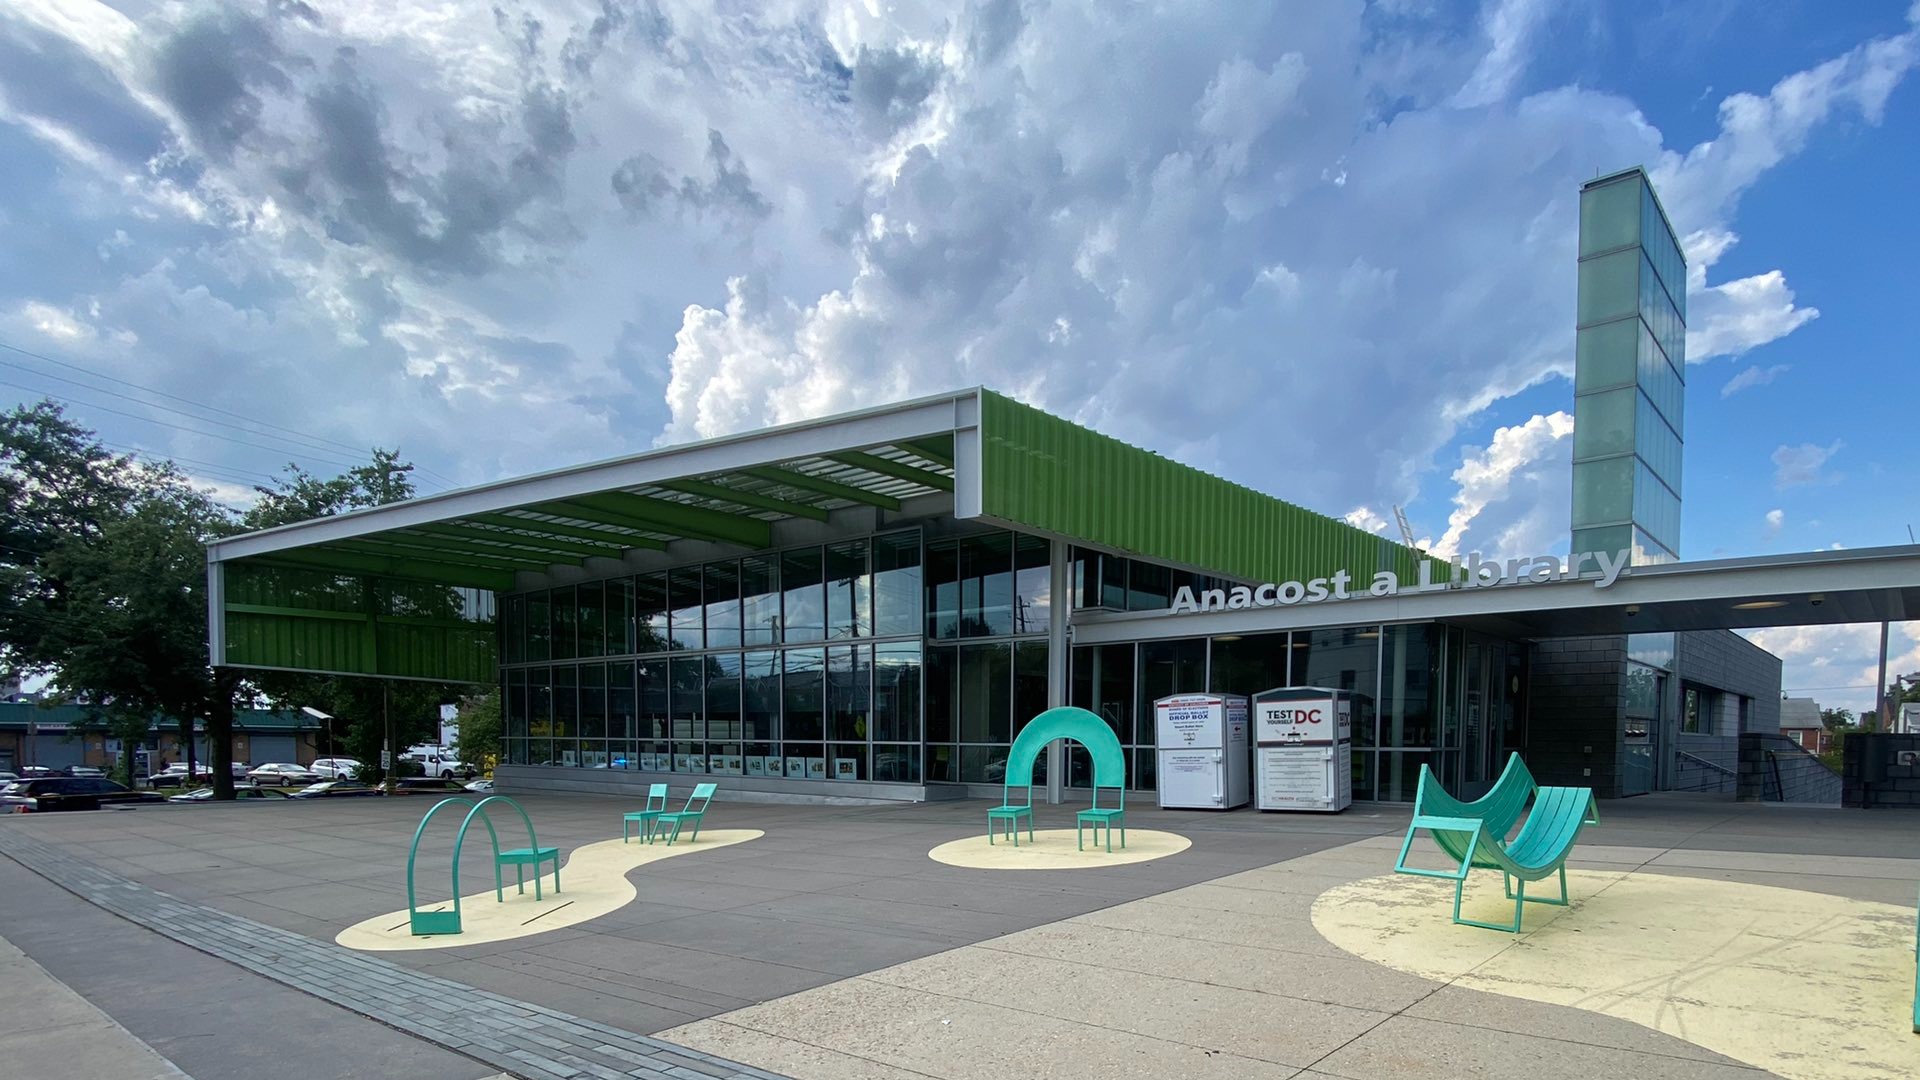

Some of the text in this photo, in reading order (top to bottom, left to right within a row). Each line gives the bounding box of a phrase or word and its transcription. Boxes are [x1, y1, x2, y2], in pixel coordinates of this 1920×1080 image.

[1419, 549, 1631, 591] Library
[1266, 709, 1322, 724] TEST DC
